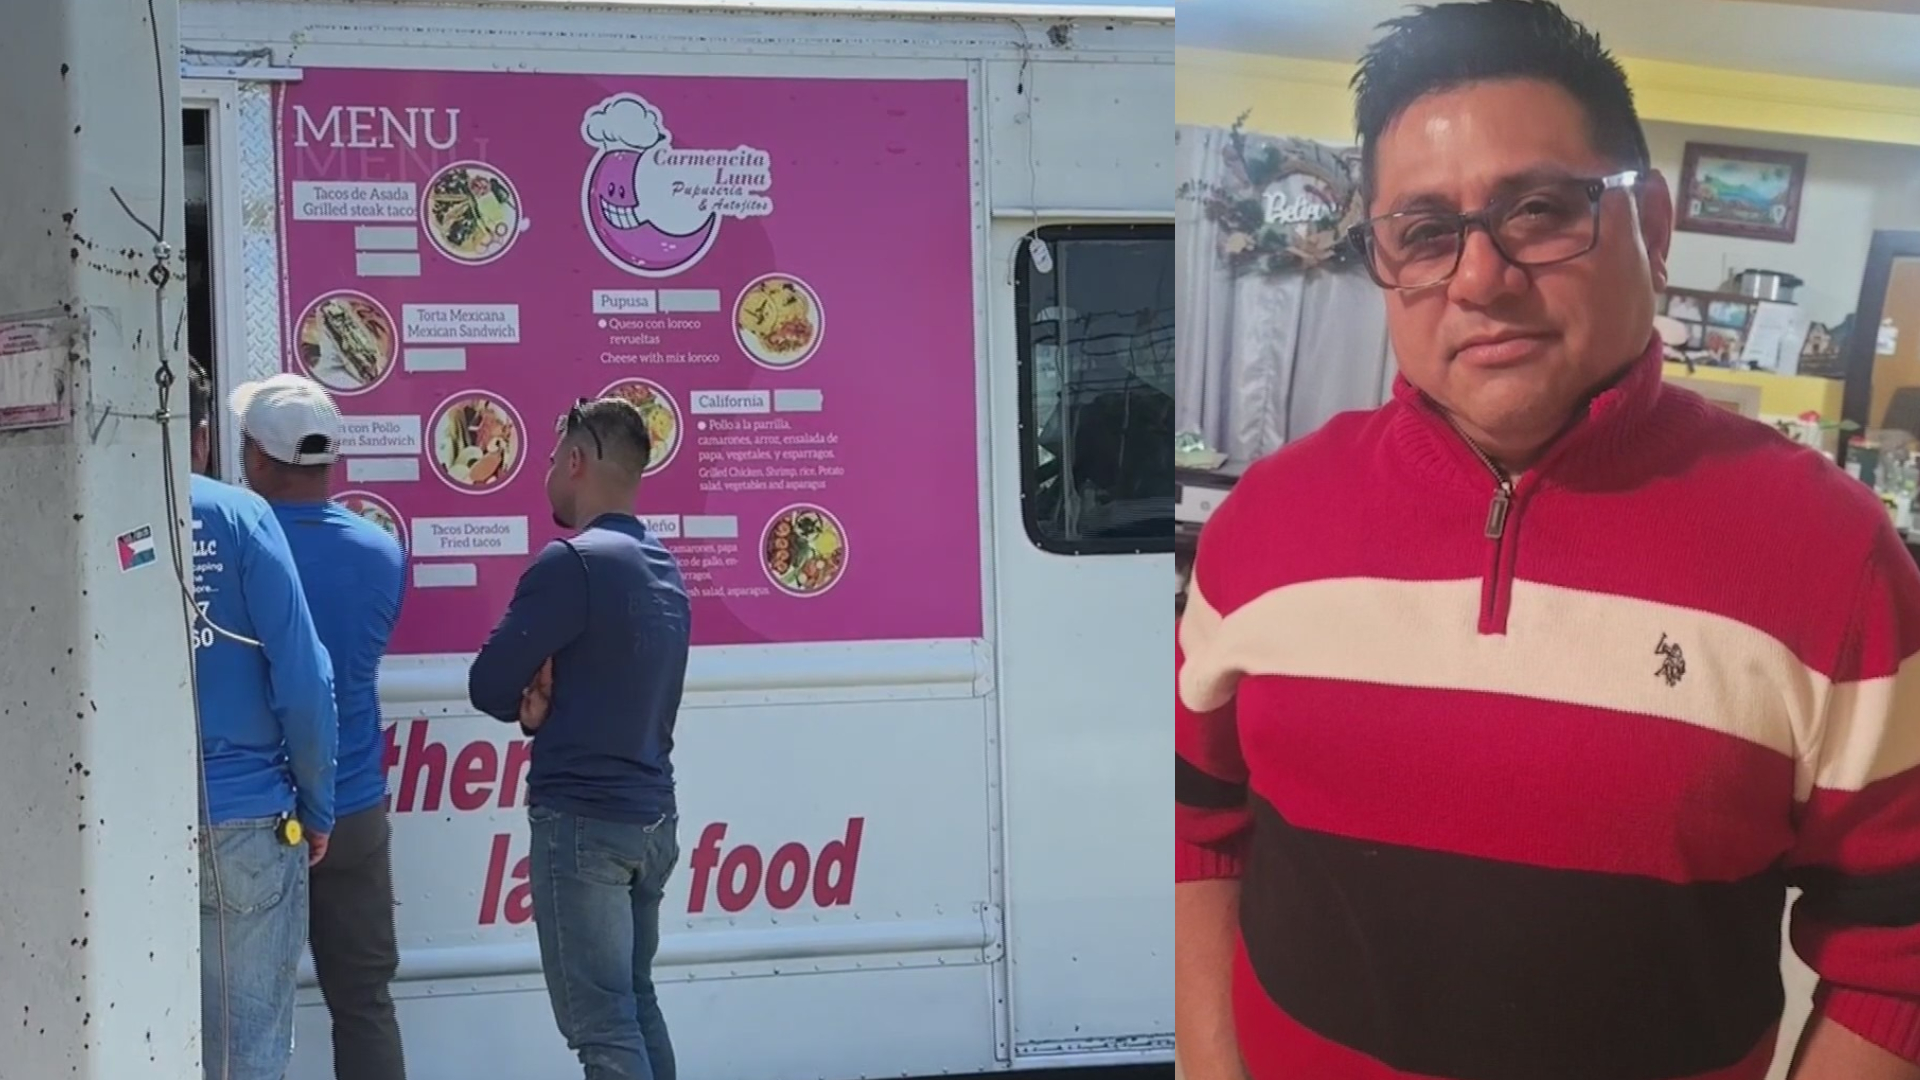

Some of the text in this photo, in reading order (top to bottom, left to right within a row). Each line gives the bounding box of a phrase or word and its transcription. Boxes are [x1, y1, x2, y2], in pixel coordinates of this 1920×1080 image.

[293, 105, 460, 149] MENU
[653, 149, 764, 166] Carmencita
[715, 167, 765, 185] Luna
[313, 187, 409, 200] Tacos de Asada
[303, 202, 347, 216] Grilled
[350, 203, 384, 217] steak
[698, 199, 768, 212] & Antojitos
[601, 294, 649, 309] Pupusa
[417, 309, 505, 321] Torta Mexicana
[408, 324, 516, 337] Mexican Sandwich
[609, 318, 701, 331] Queso con loroco
[610, 333, 660, 345] revueltas
[600, 352, 720, 364] Cheese with mix loroco
[699, 395, 764, 409] California
[347, 424, 370, 433] con
[372, 421, 400, 433] Pollo
[709, 420, 734, 430] Pollo
[735, 422, 741, 430] a
[742, 419, 752, 430] la
[359, 435, 415, 446] Sandwich
[782, 432, 825, 444] ensalada
[826, 432, 838, 443] de
[768, 479, 784, 490] and
[431, 524, 510, 535] Tacos Dorados
[441, 538, 502, 548] Fried tacos
[687, 817, 864, 913] food
